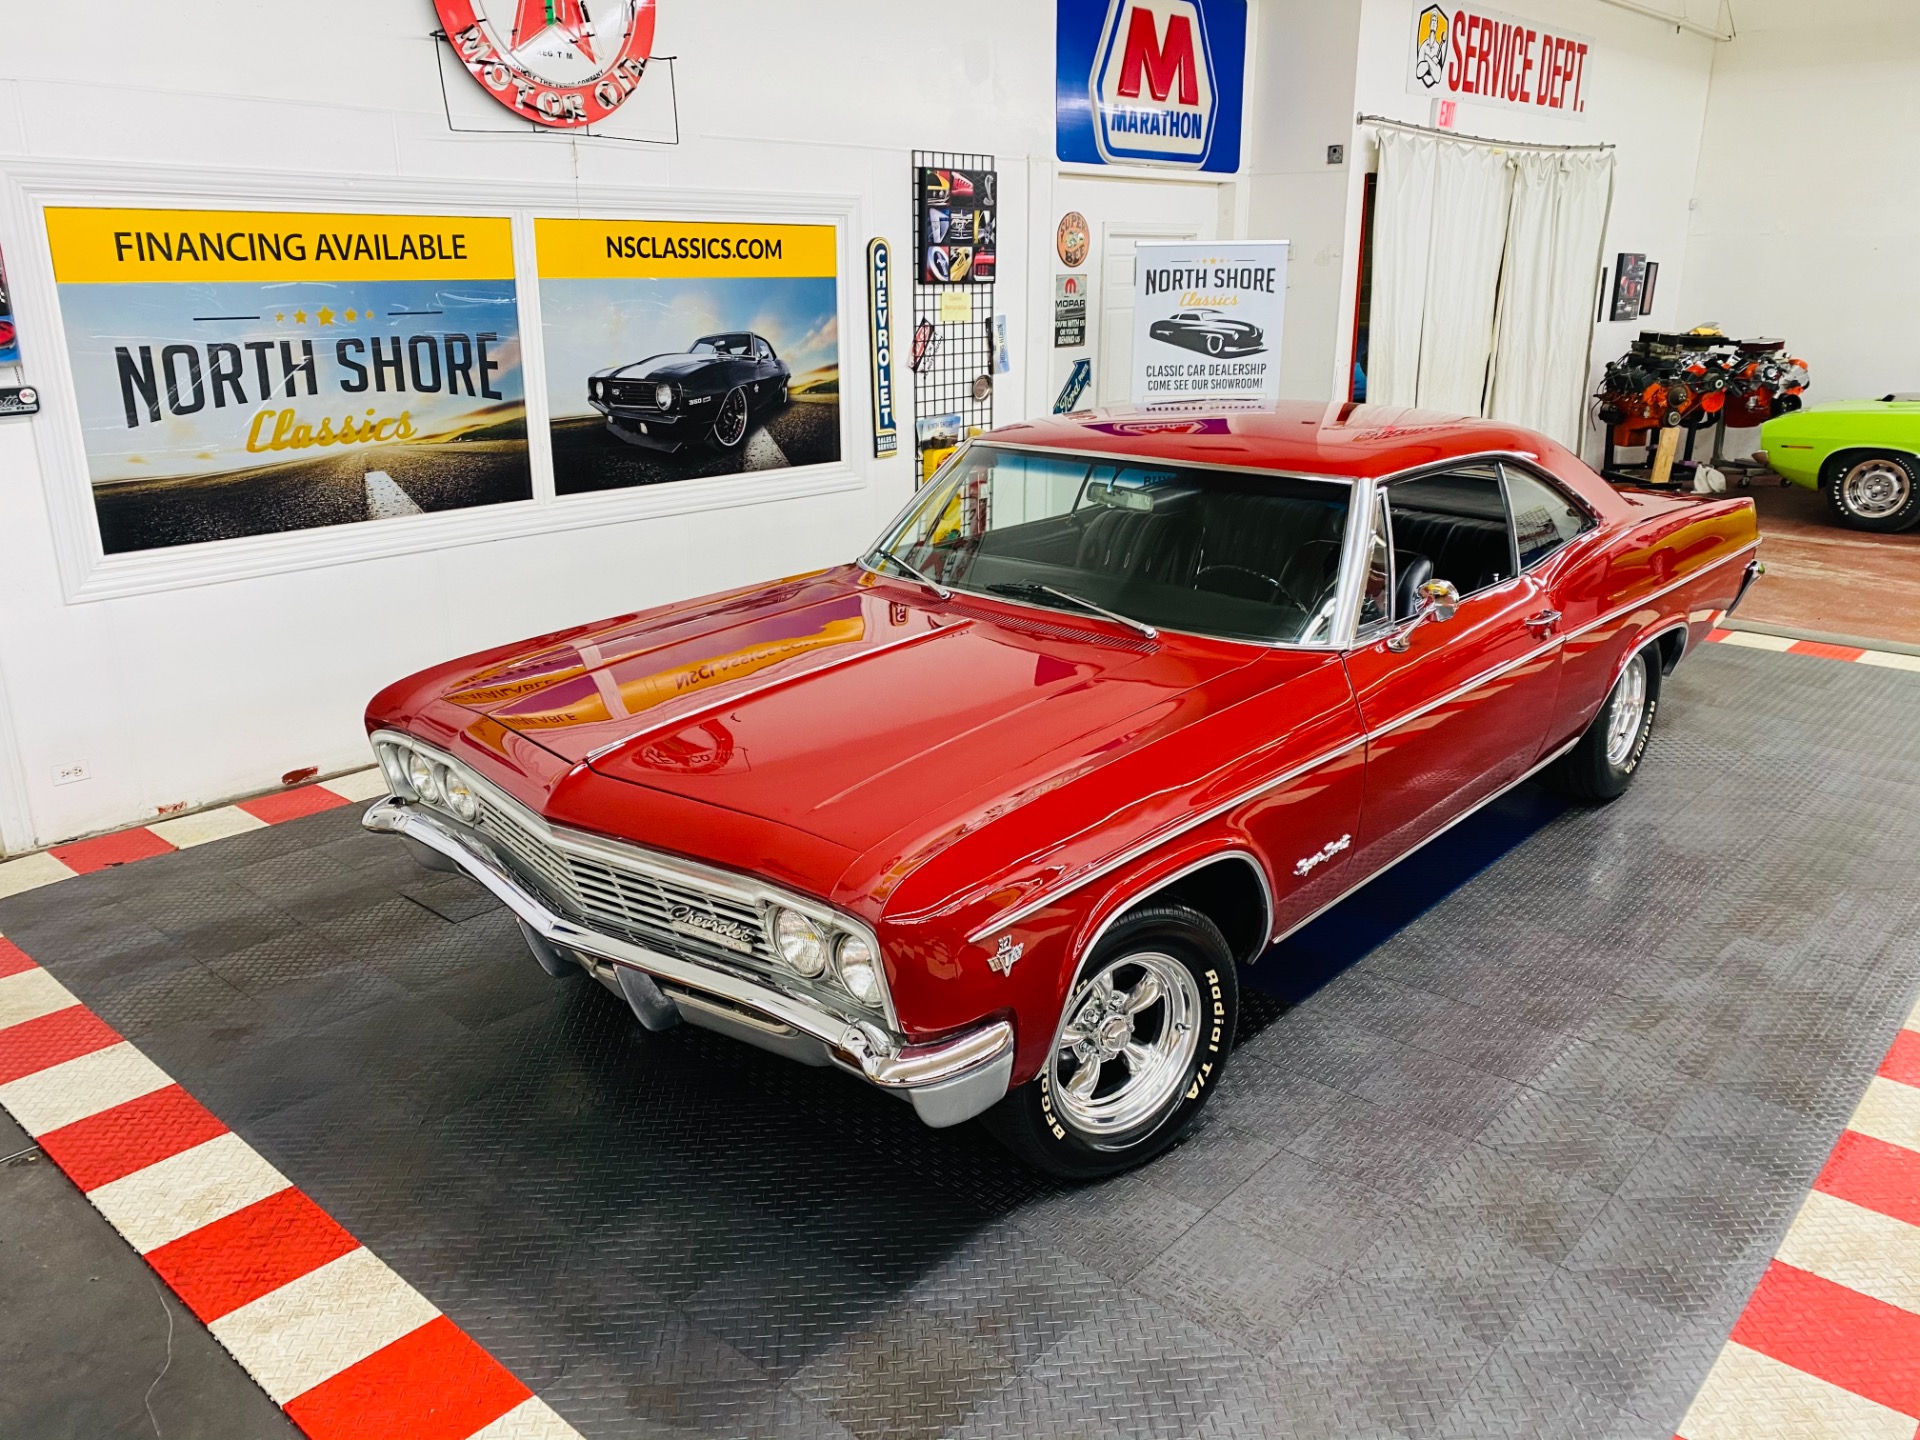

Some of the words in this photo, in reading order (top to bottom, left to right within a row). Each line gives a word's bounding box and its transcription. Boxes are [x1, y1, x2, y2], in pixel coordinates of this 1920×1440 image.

[454, 24, 588, 123] MOTOR
[594, 56, 648, 110] OIL
[1448, 10, 1537, 103] SERVICE
[1536, 34, 1588, 113] DEPT.
[1111, 107, 1202, 139] MARATHON
[113, 231, 306, 262] FINANCING
[315, 233, 468, 261] AVAILABLE
[605, 235, 783, 260] NSCLASSICS.COM
[1145, 268, 1208, 296] NORTH
[1213, 267, 1276, 294] SHORE
[1178, 291, 1239, 307] Classics
[1055, 300, 1086, 308] MOPAR
[875, 249, 891, 426] CHEVROLET
[114, 338, 318, 429] NORTH
[336, 332, 503, 401] SHORE
[1146, 364, 1185, 378] CLASSIC
[1186, 364, 1206, 377] CAR
[1208, 363, 1267, 376] DEALERSHIP
[1147, 379, 1171, 391] COME
[1173, 379, 1189, 390] SEE
[1191, 378, 1209, 390] OUR
[1210, 377, 1263, 390] SHOWROOM!
[246, 407, 419, 454] Classics
[670, 904, 756, 942] Chevrolet
[1204, 968, 1225, 1053] Radial
[1185, 1062, 1213, 1100] T/A
